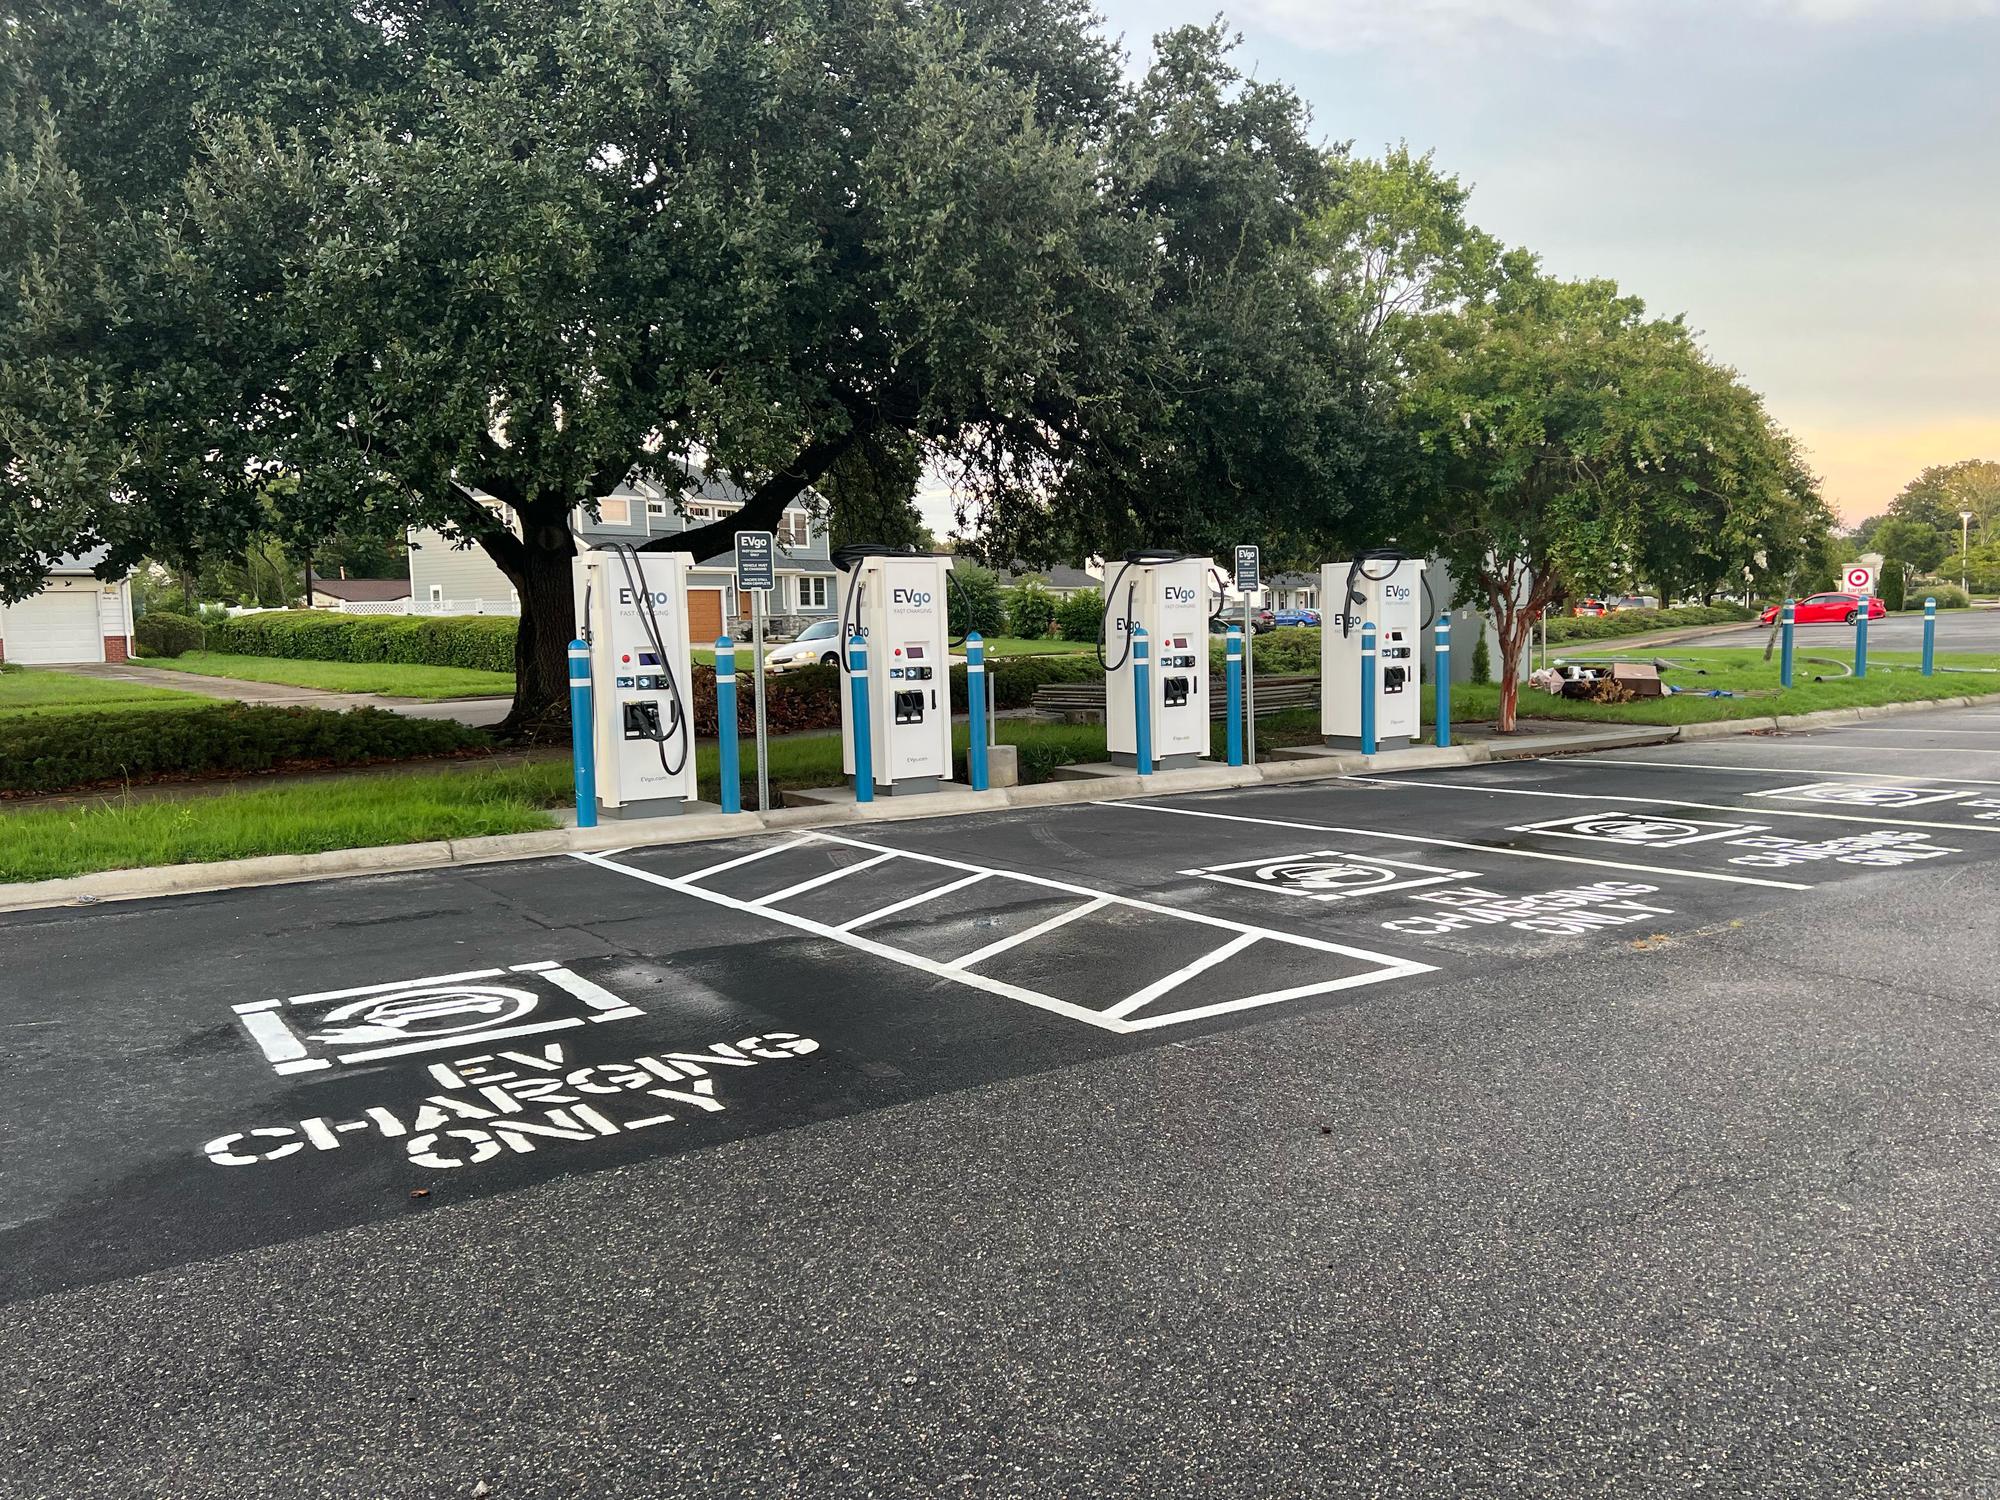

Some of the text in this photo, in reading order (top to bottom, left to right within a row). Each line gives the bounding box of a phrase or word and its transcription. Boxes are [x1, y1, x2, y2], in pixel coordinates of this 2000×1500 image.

[741, 536, 767, 548] EVgo
[1239, 550, 1255, 559] EVgo
[894, 589, 931, 607] EVgo
[1165, 587, 1195, 603] EVgo
[1386, 586, 1410, 600] EVgo
[1724, 835, 1807, 848] EV
[1728, 830, 1931, 867] CHARGING
[1836, 843, 1963, 866] ONLY
[1408, 887, 1507, 906] EV
[1381, 881, 1660, 934] CHARGING
[1510, 900, 1675, 935] ONLY
[427, 1043, 564, 1089] EV
[204, 1032, 820, 1166] CHARGING
[406, 1079, 726, 1169] ONLY
